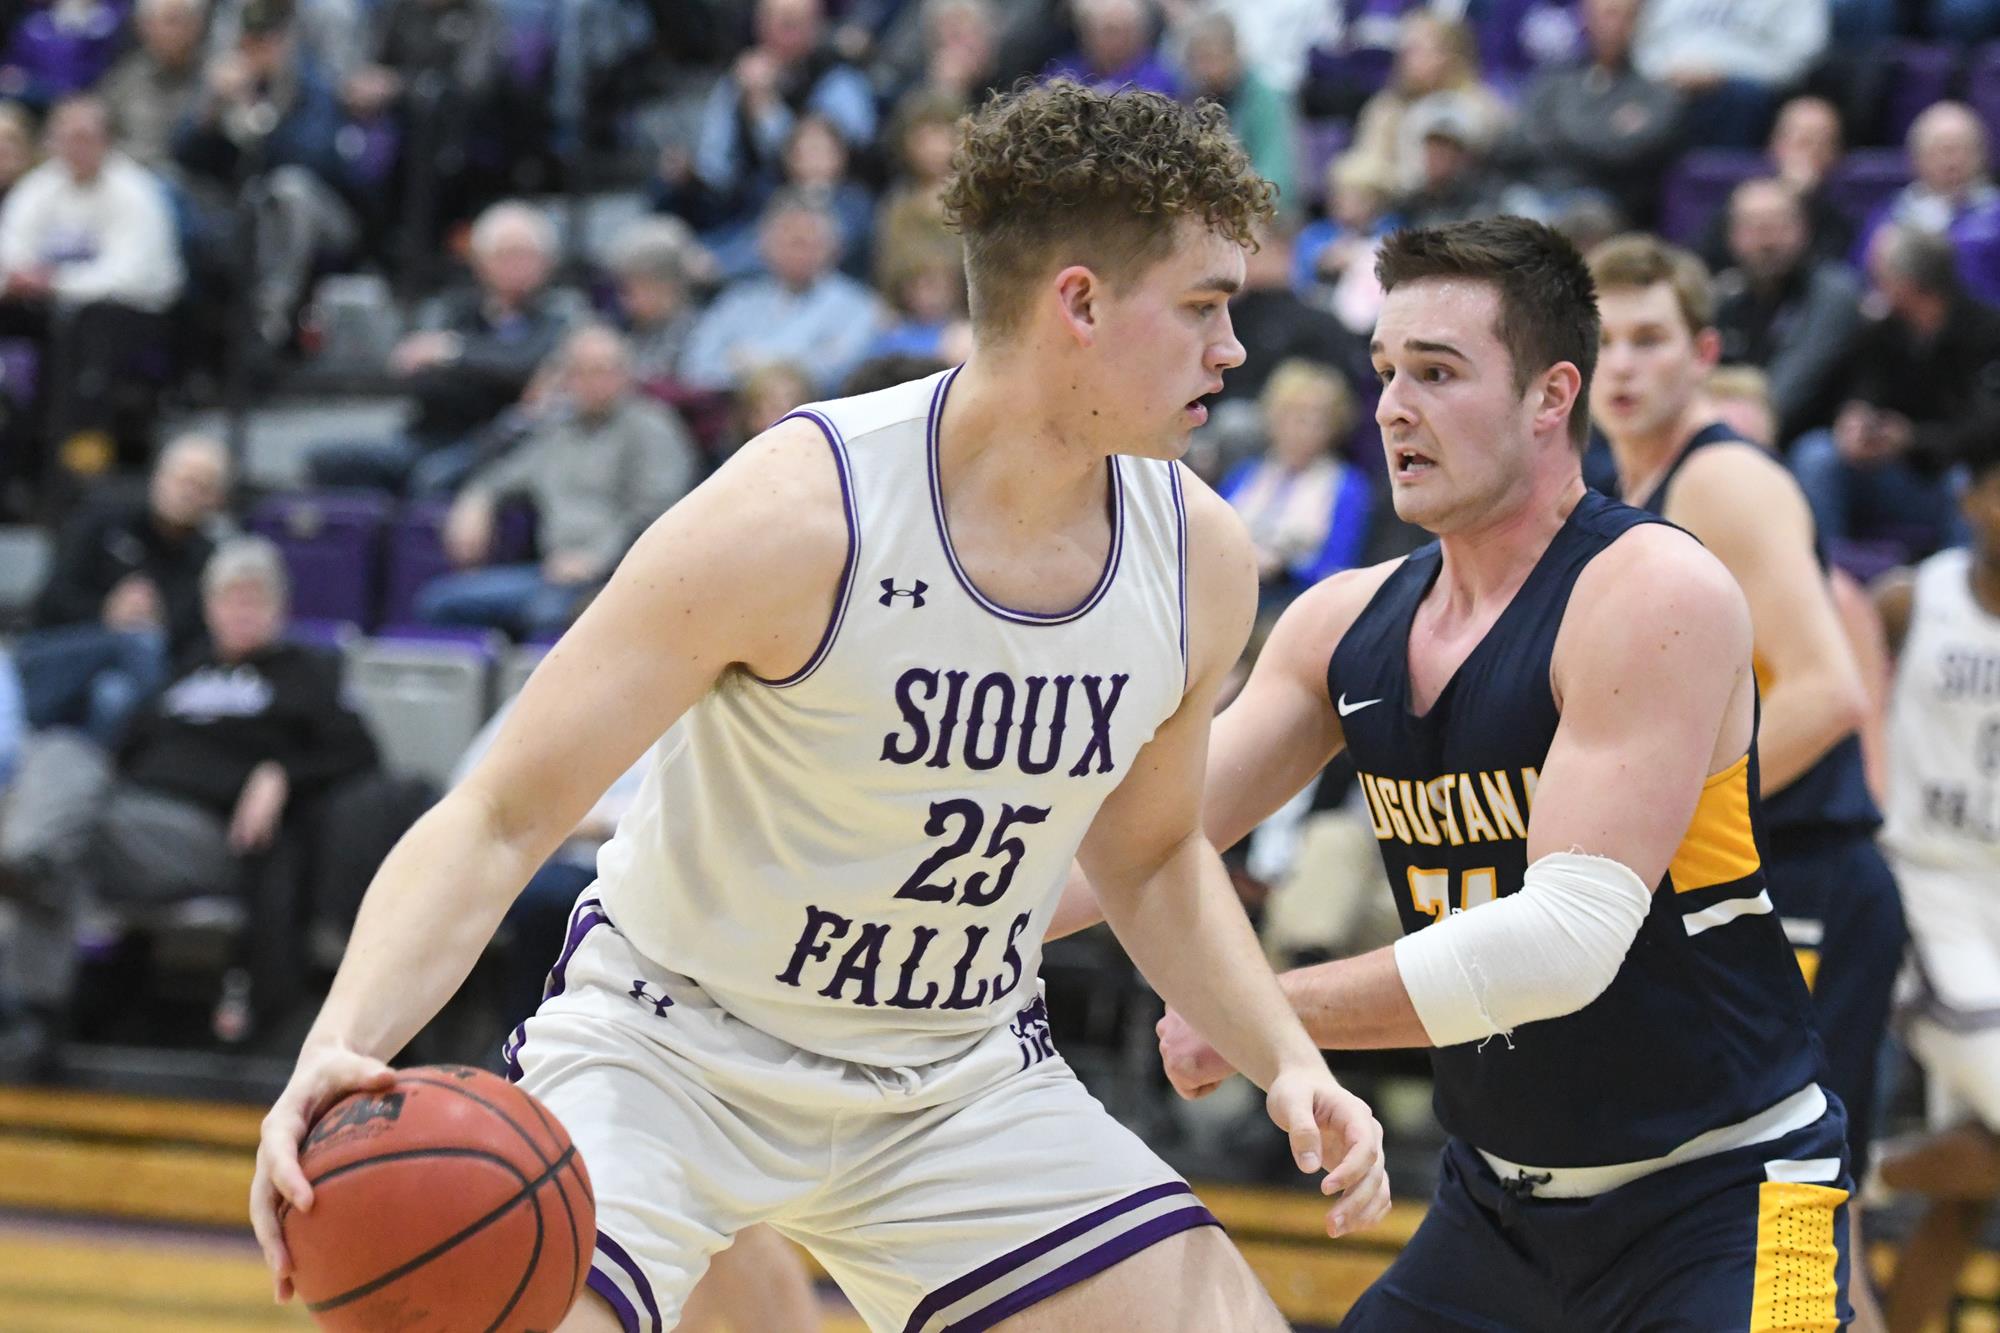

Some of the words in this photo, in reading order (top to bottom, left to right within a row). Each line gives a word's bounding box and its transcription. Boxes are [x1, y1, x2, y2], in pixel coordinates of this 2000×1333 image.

[880, 667, 1129, 777] SIOUX
[893, 797, 1052, 907] 25
[775, 905, 1031, 1010] FALLS
